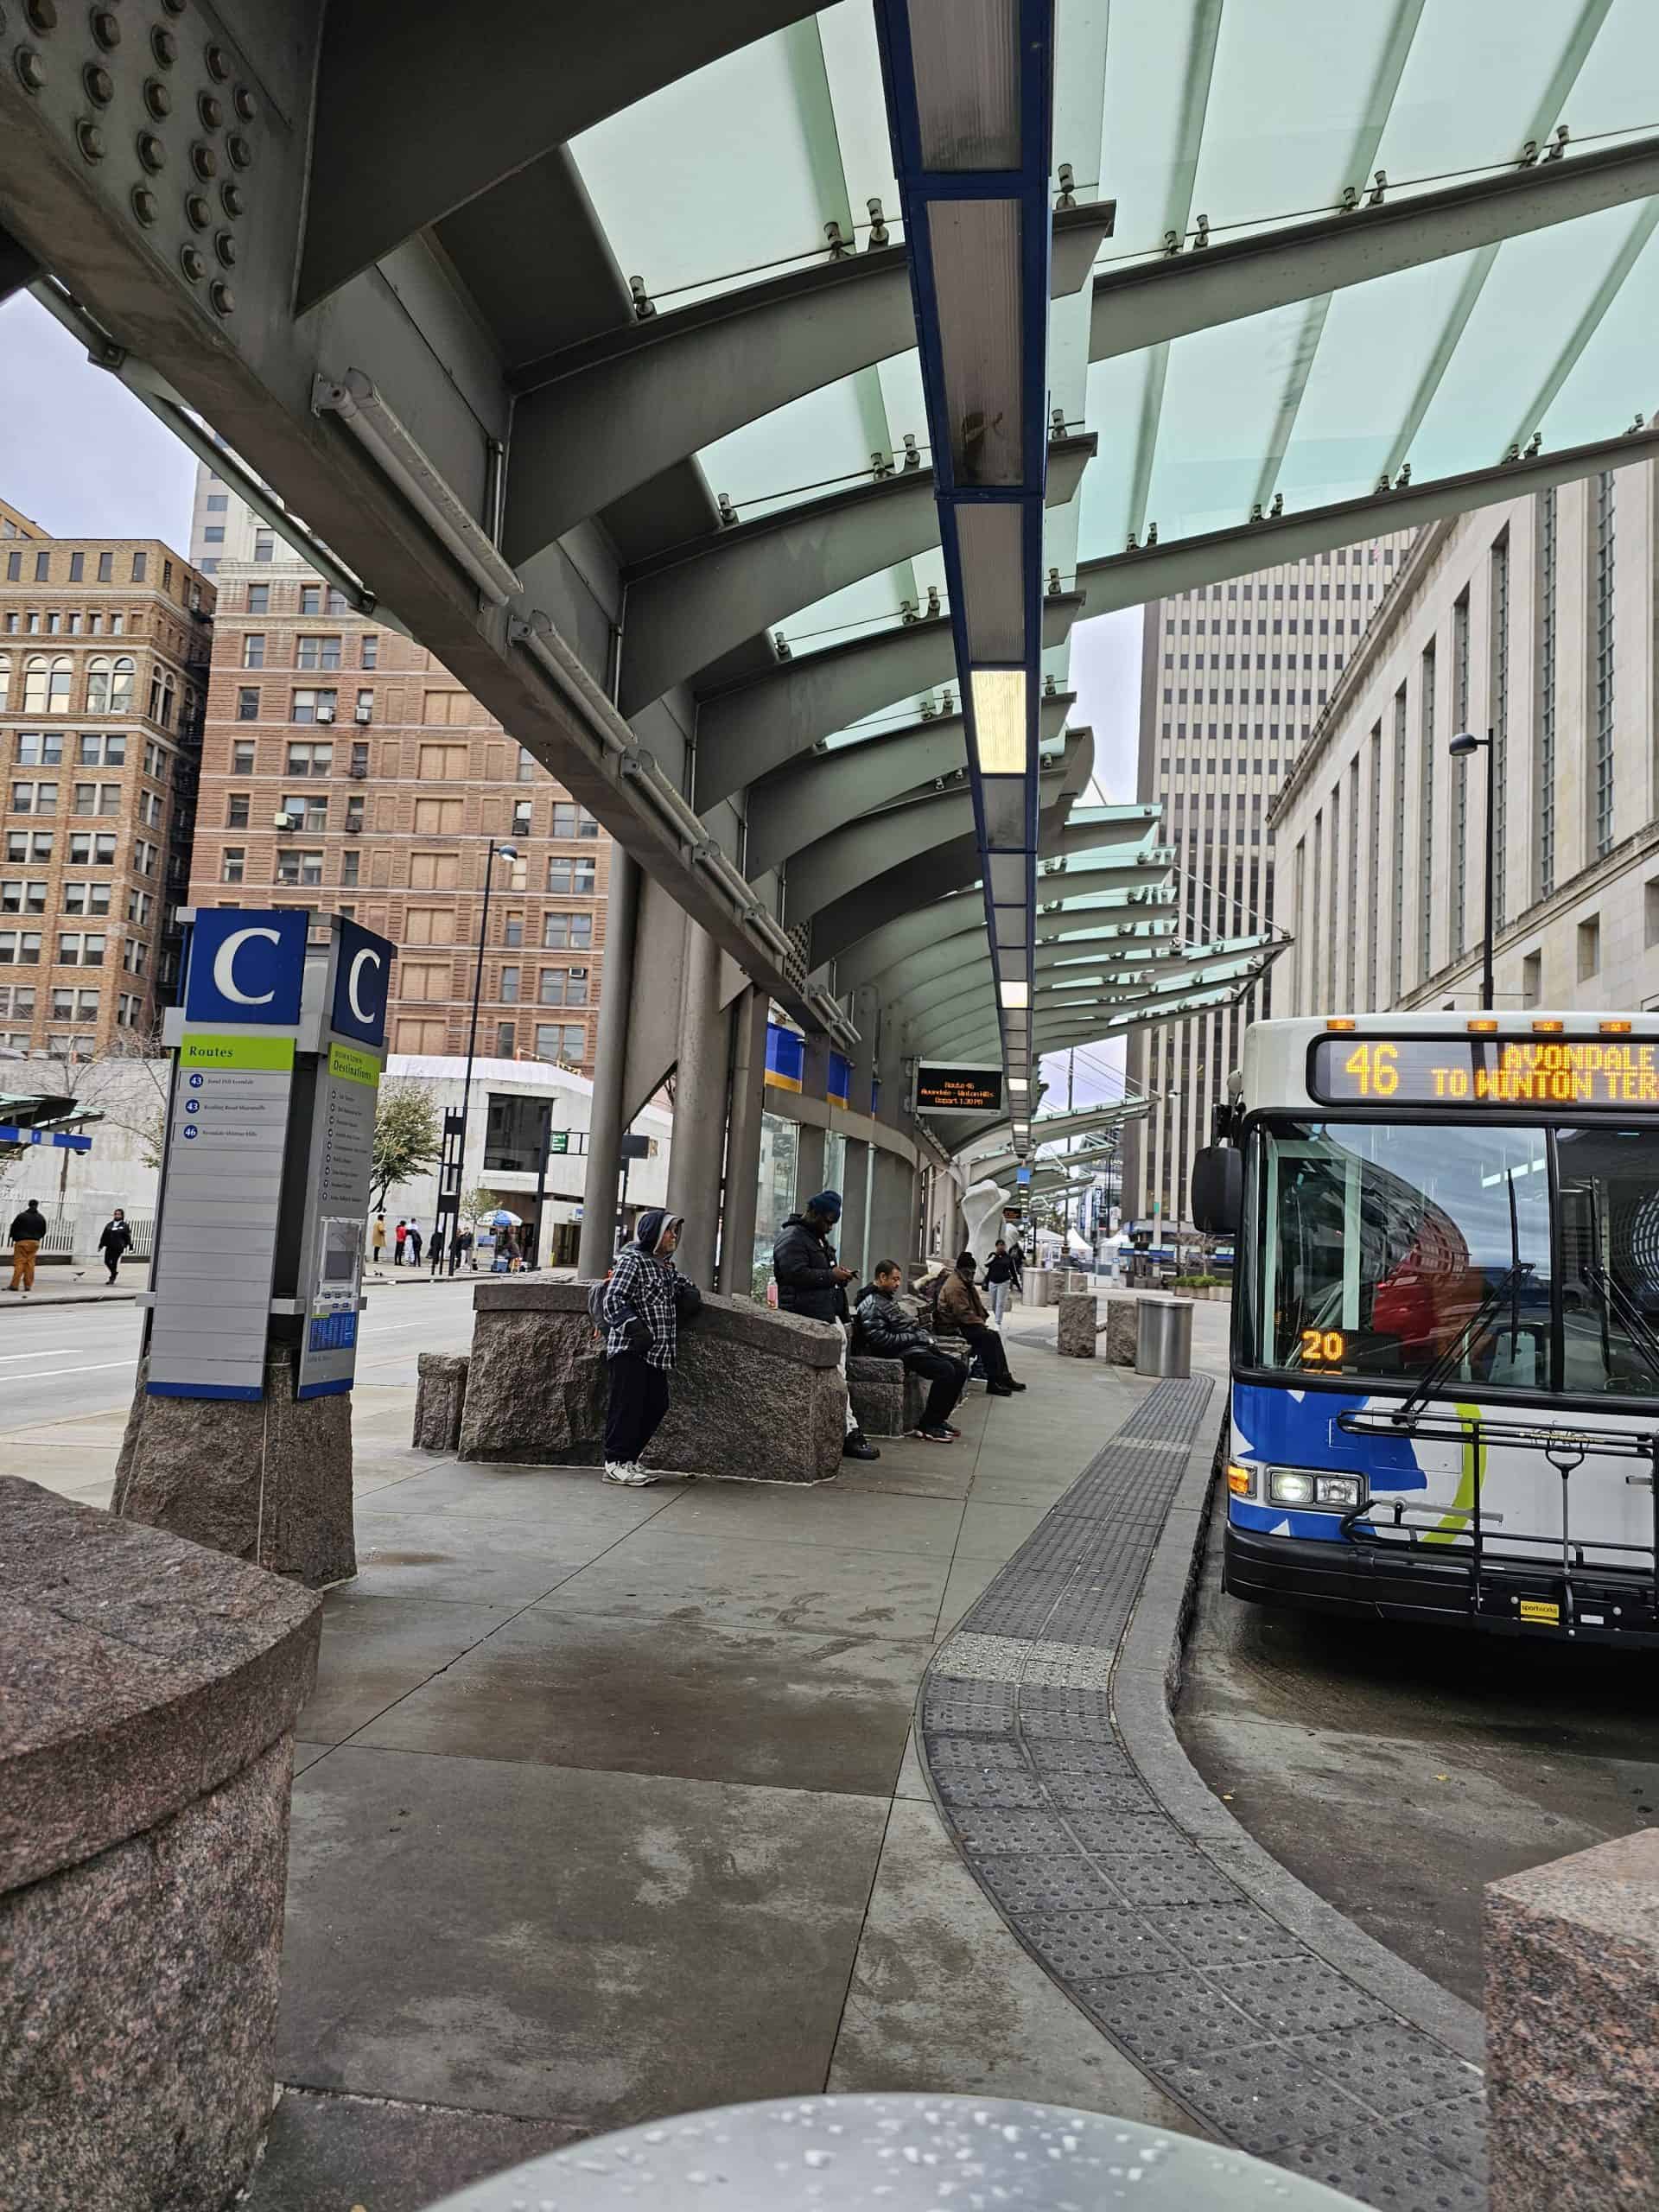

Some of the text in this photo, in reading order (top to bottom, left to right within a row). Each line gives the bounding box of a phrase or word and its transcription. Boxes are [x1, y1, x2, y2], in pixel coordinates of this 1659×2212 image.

[213, 927, 282, 1005] C
[348, 948, 381, 1025] C
[189, 1046, 234, 1058] Routes
[1503, 1045, 1655, 1071] AVONDALE
[191, 1077, 202, 1085] 43
[334, 1059, 372, 1079] Destinations
[1345, 1043, 1399, 1097] 46
[1430, 1068, 1466, 1097] TO
[1476, 1070, 1592, 1100] WINTON
[187, 1103, 199, 1112] 43
[185, 1128, 196, 1137] 46
[1302, 1331, 1344, 1360] 20
